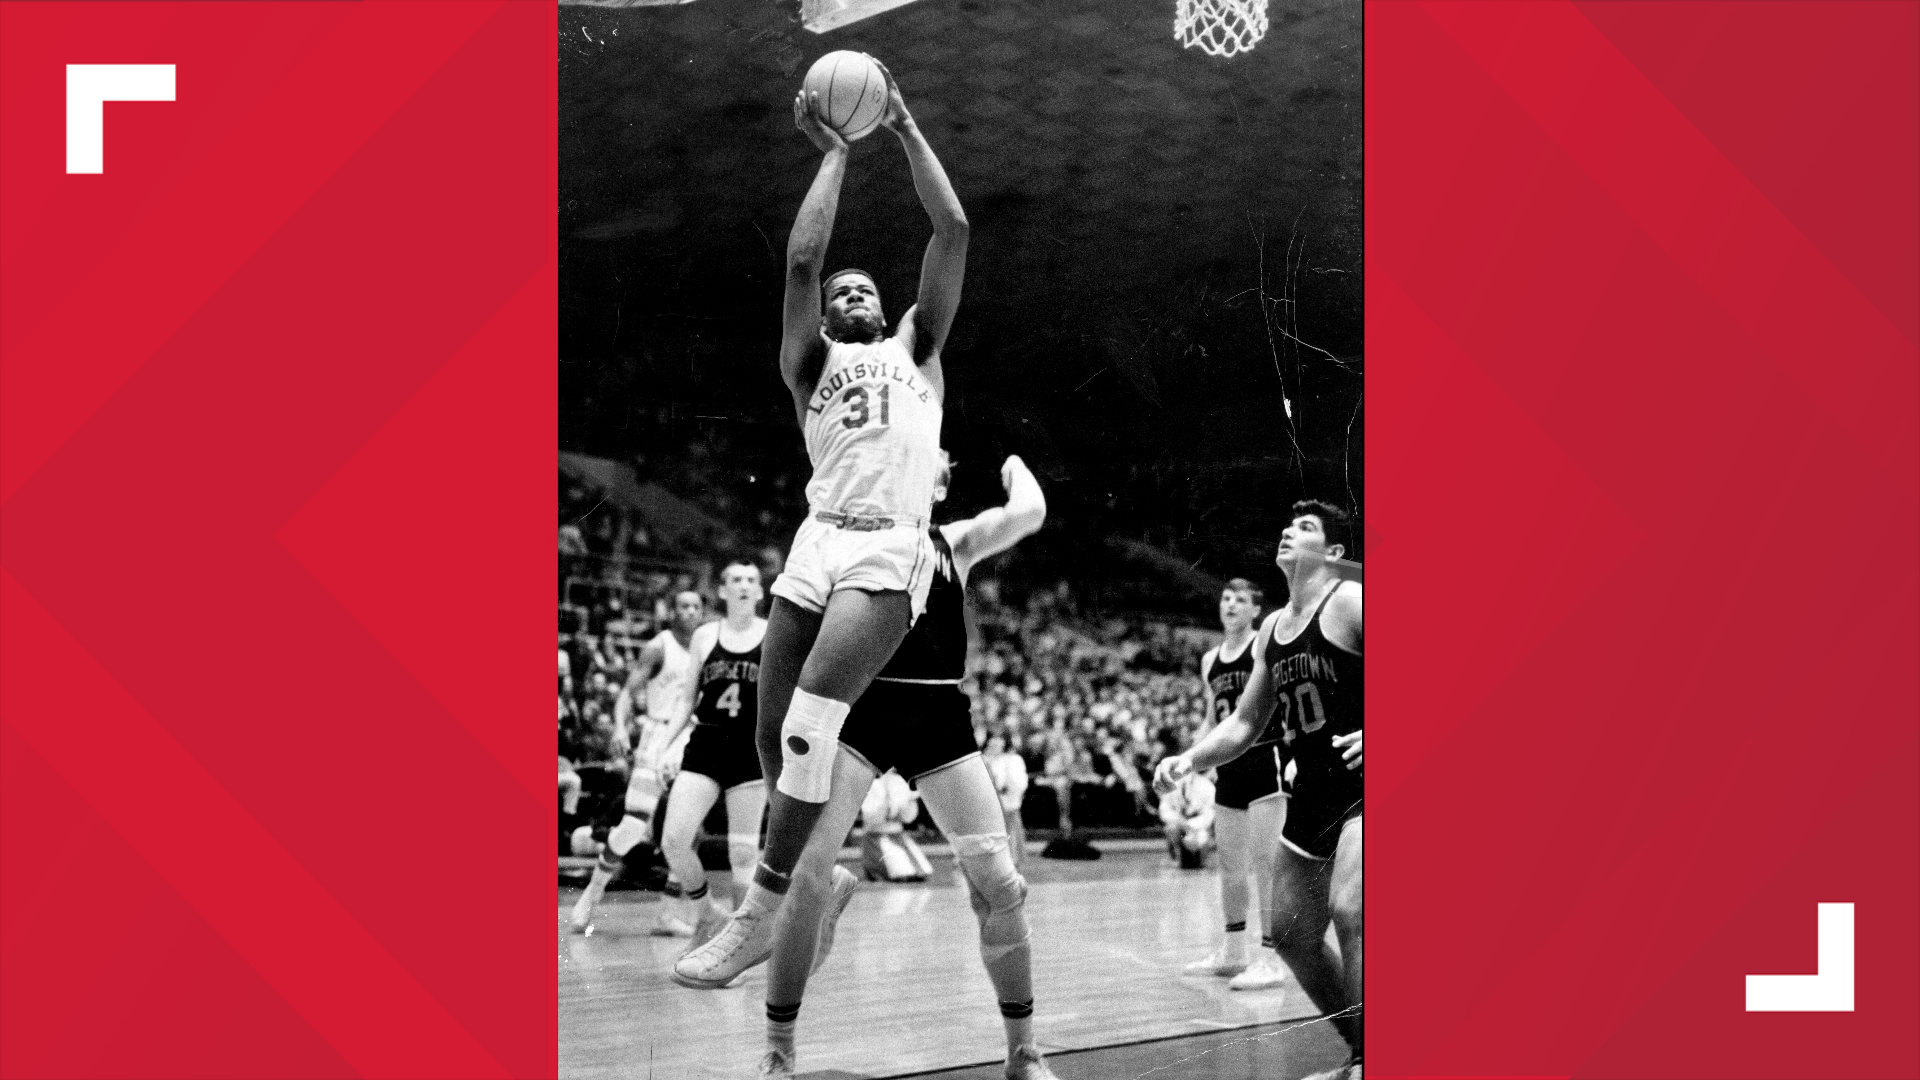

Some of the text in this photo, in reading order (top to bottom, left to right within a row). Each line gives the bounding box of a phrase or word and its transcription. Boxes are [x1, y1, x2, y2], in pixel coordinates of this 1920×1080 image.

[808, 362, 932, 416] LOUISVILLE
[842, 384, 890, 430] 31
[715, 682, 742, 718] 4
